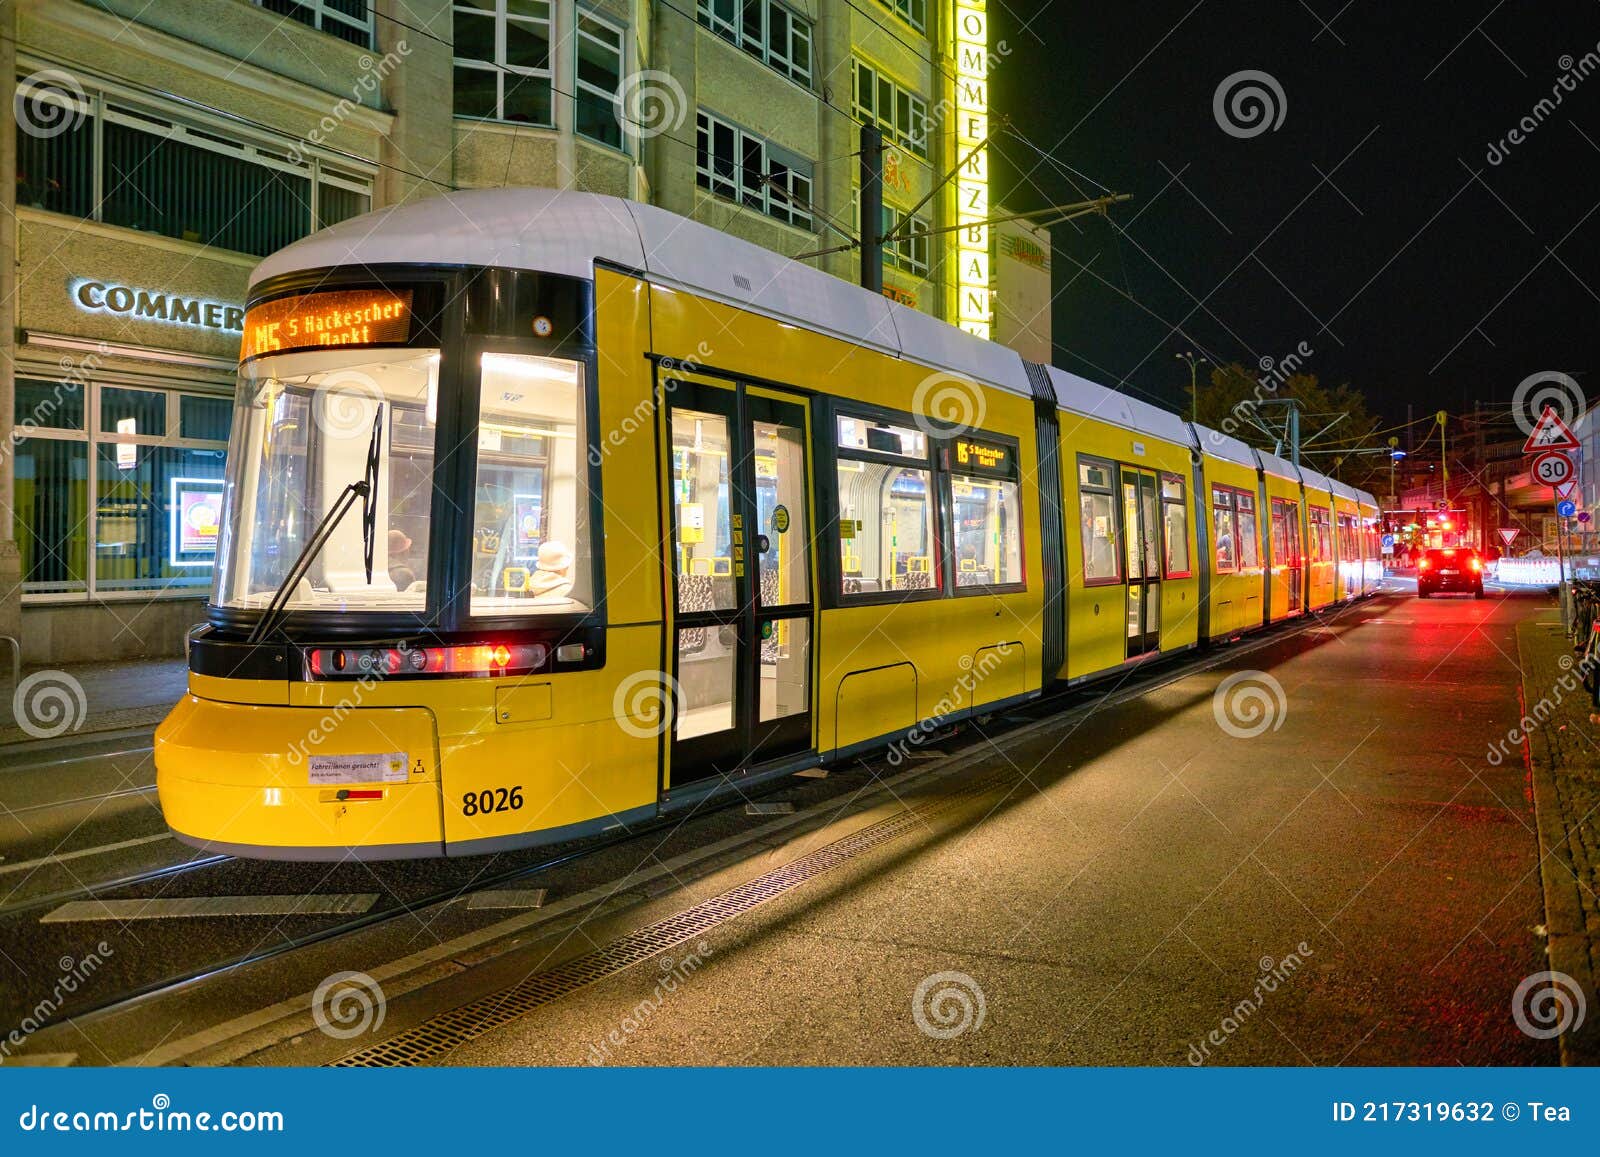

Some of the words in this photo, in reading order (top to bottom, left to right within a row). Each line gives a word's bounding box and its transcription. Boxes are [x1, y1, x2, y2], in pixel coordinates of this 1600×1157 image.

[963, 0, 984, 337] OMMERZBAN
[78, 281, 244, 332] COMMER
[255, 322, 282, 353] M5
[289, 318, 298, 337] S
[305, 302, 403, 333] Hackescher
[320, 326, 369, 345] Markt
[1541, 461, 1565, 478] 30
[462, 786, 524, 817] 8026
